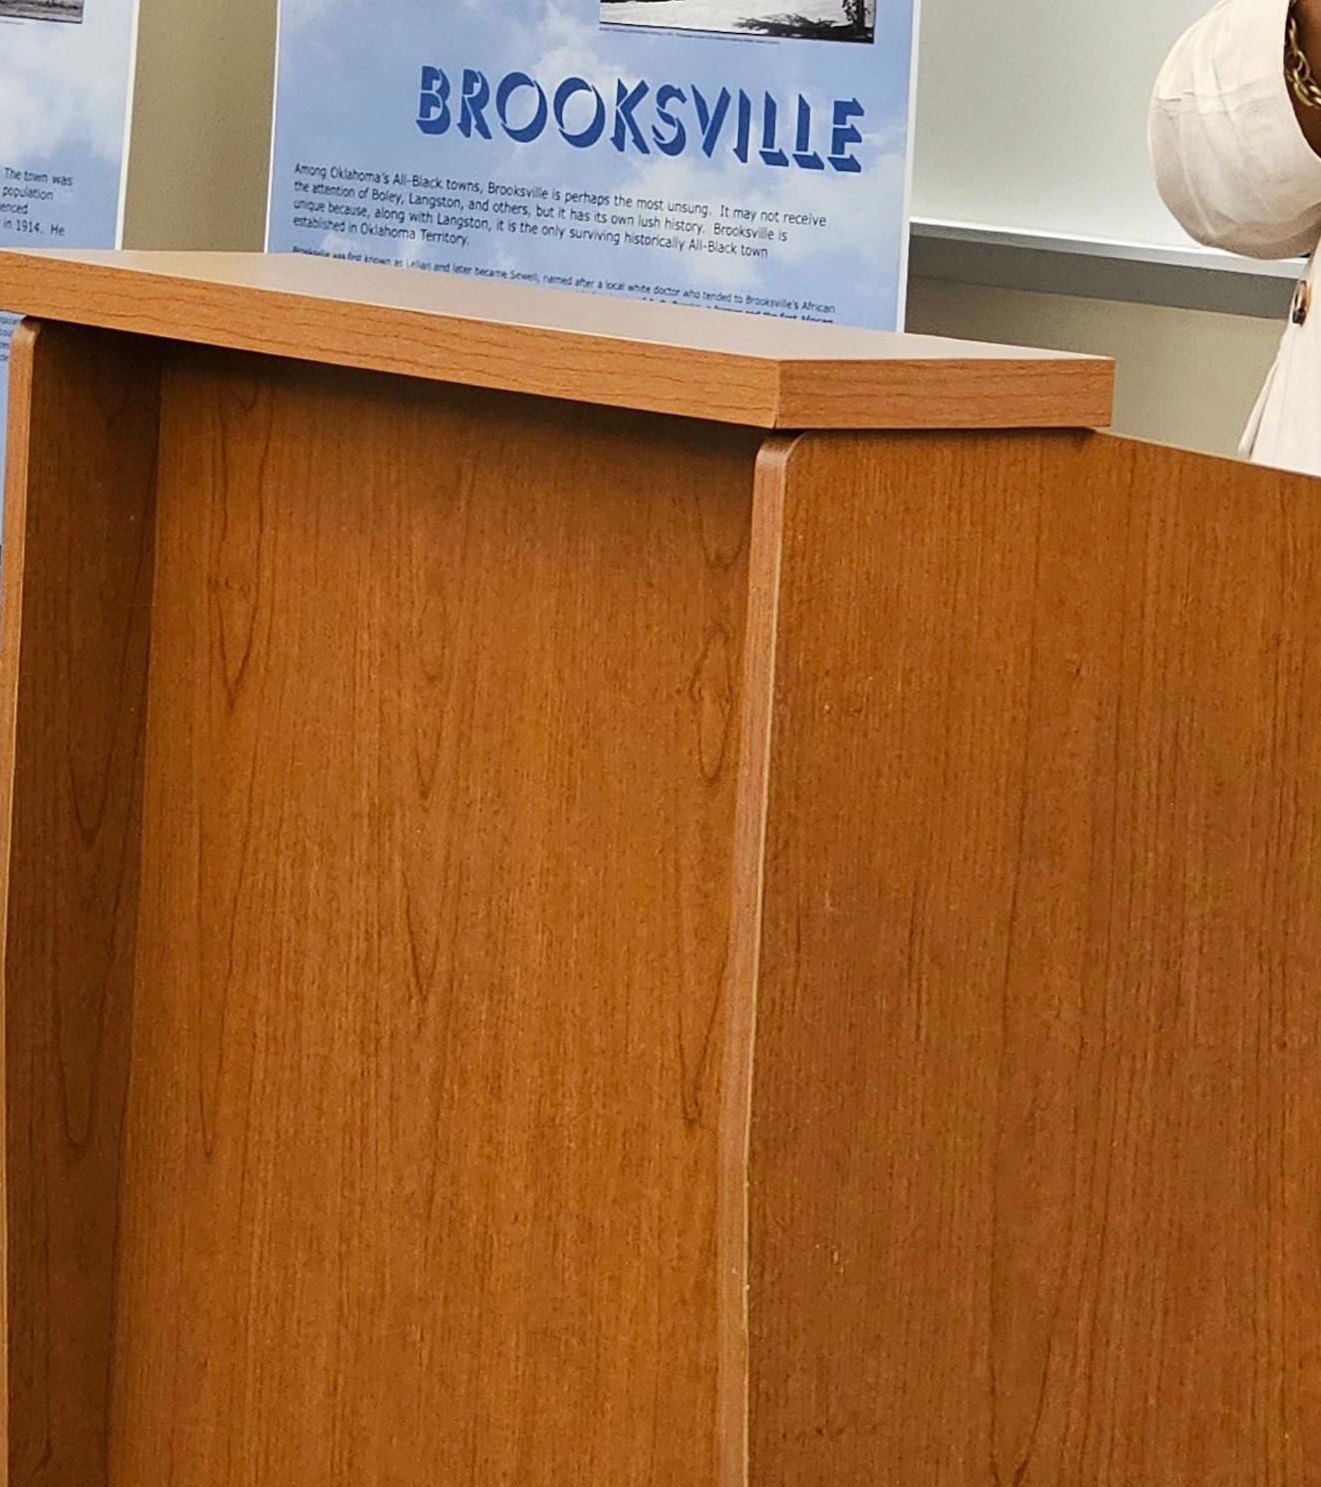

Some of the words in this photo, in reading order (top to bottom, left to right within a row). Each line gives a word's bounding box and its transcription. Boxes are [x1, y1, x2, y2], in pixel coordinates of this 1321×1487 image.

[416, 66, 864, 172] BROOKSVILLE
[294, 179, 309, 194] the
[312, 181, 355, 198] attention
[358, 186, 368, 199] of
[371, 187, 407, 206] Boley,
[408, 190, 465, 211] Langston,
[468, 197, 489, 211] and
[492, 199, 533, 218] others,
[536, 203, 554, 217] but
[558, 205, 565, 219] it
[570, 206, 590, 221] has
[594, 208, 607, 223] its
[610, 214, 634, 225] own
[638, 213, 660, 228] lush
[664, 216, 707, 236] history.
[713, 221, 774, 240] Brooksville
[778, 227, 787, 241] is
[295, 161, 326, 181] Among
[330, 165, 389, 183] Oklahoma's
[392, 171, 442, 188] All-Black
[446, 176, 485, 195] towns,
[488, 180, 548, 199] Brooksville
[552, 186, 560, 200] is
[564, 189, 610, 208] perhaps
[614, 192, 632, 207] the
[636, 197, 663, 210] most
[667, 201, 714, 218] unsung.
[720, 203, 729, 217] It
[733, 208, 756, 223] may
[760, 208, 779, 222] not
[783, 211, 826, 226] receive
[293, 216, 345, 233] established
[348, 221, 357, 235] in
[360, 222, 415, 241] Oklahoma
[422, 228, 469, 249] Territory.
[294, 198, 325, 215] unique
[328, 200, 374, 221] because,
[374, 206, 405, 225] along
[409, 209, 433, 224] with
[436, 212, 493, 233] Langston,
[496, 217, 503, 231] it
[508, 219, 516, 232] is
[520, 220, 538, 234] the
[541, 223, 565, 241] only
[569, 227, 620, 246] surviving
[624, 230, 684, 253] historically
[688, 237, 737, 254] All-Black
[740, 242, 768, 257] town
